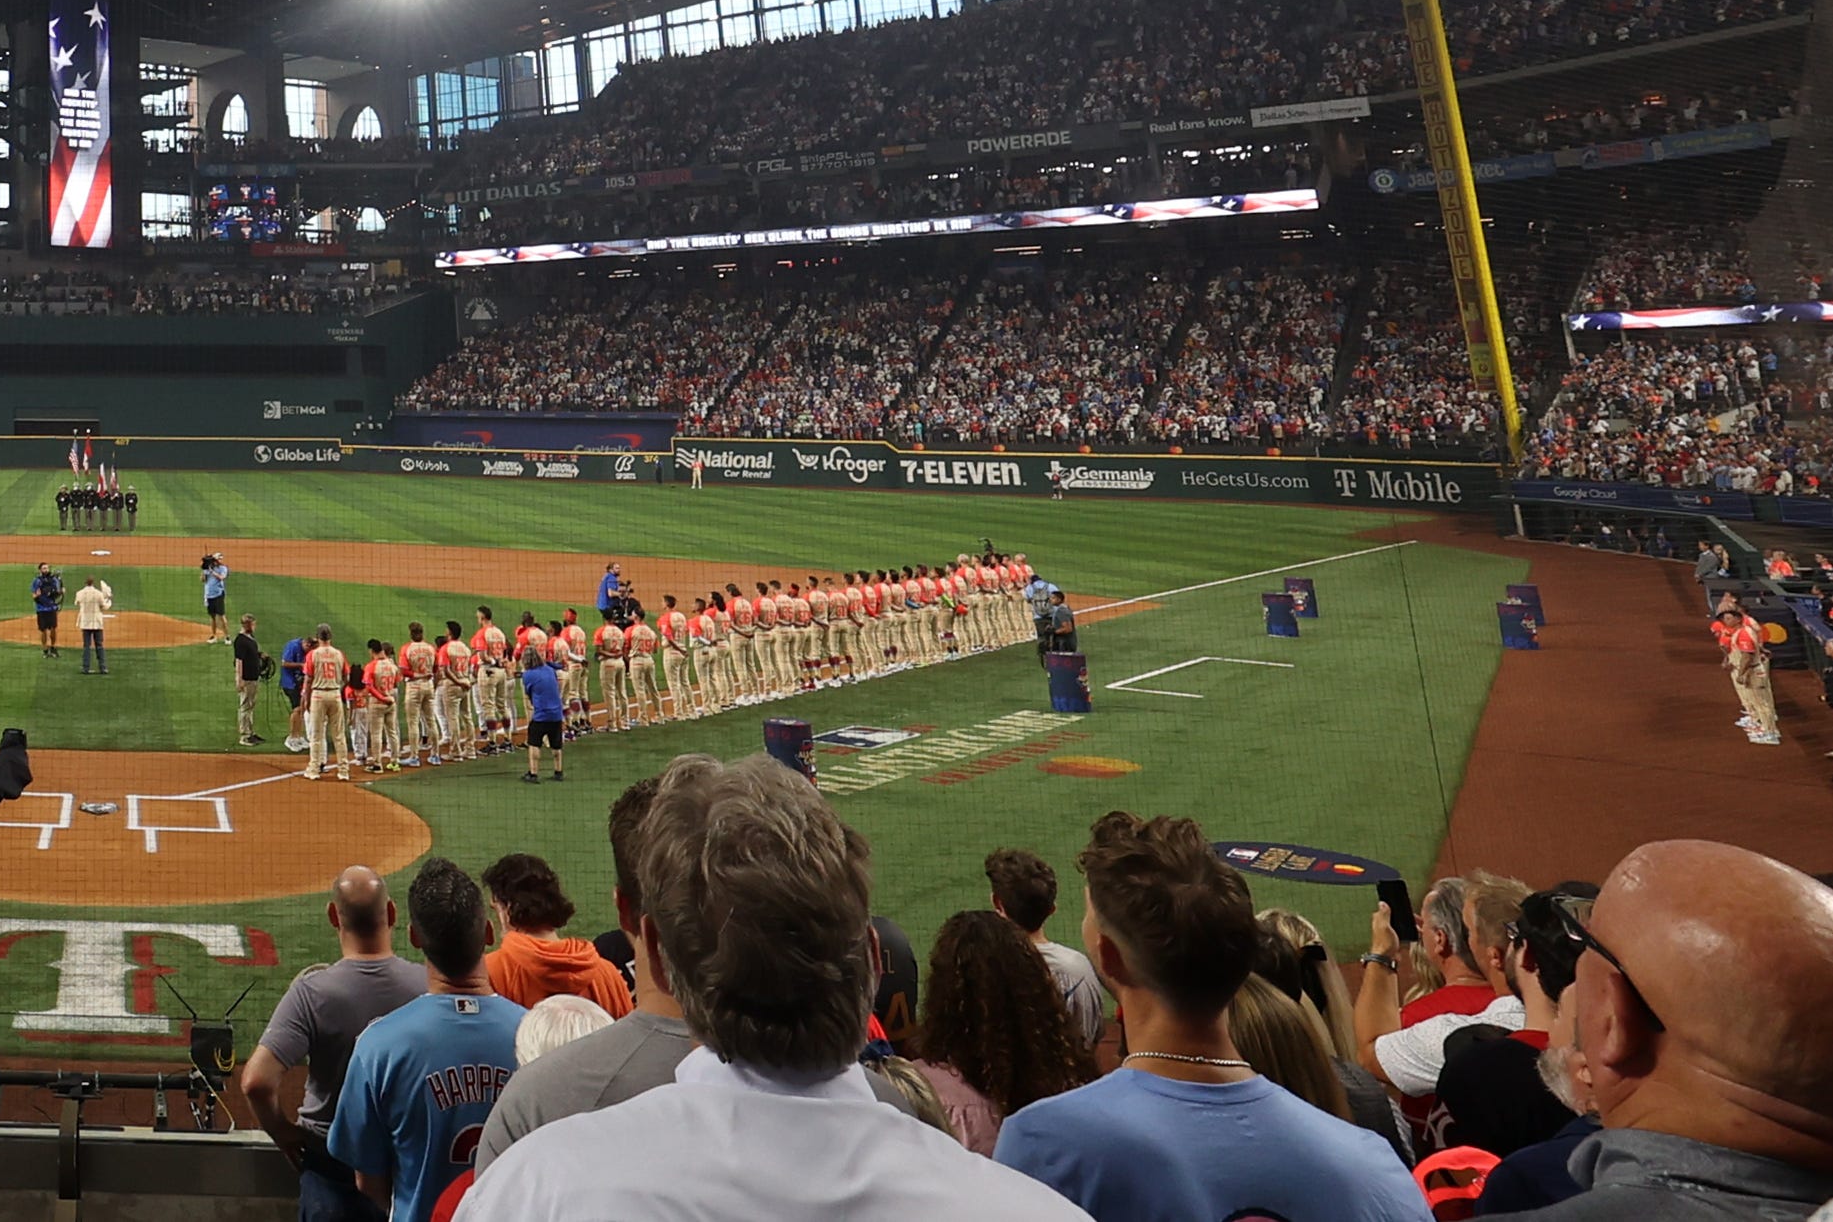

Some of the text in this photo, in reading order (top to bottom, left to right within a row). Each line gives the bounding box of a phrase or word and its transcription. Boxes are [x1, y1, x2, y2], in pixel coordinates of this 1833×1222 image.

[1149, 115, 1246, 134] Real fans know.
[967, 130, 1072, 155] POWERADE
[756, 158, 793, 173] PGL
[604, 175, 636, 189] 105.3
[457, 180, 562, 204] UT DALLAS
[669, 238, 689, 248] THE
[744, 233, 766, 244] RED
[805, 228, 828, 240] THE
[872, 221, 931, 236] BURSTING
[933, 220, 947, 231] IN
[950, 218, 972, 230] AIR
[281, 405, 326, 415] BETMGM
[274, 448, 341, 462] Globe Life
[822, 445, 887, 483] Kroger
[723, 470, 771, 479] Car Rental
[1075, 466, 1154, 482] Germania
[1181, 470, 1310, 488] HeGetsUs.com
[1366, 468, 1462, 504] Mobile
[1553, 485, 1588, 501] Google
[426, 1064, 511, 1110] HARPE
